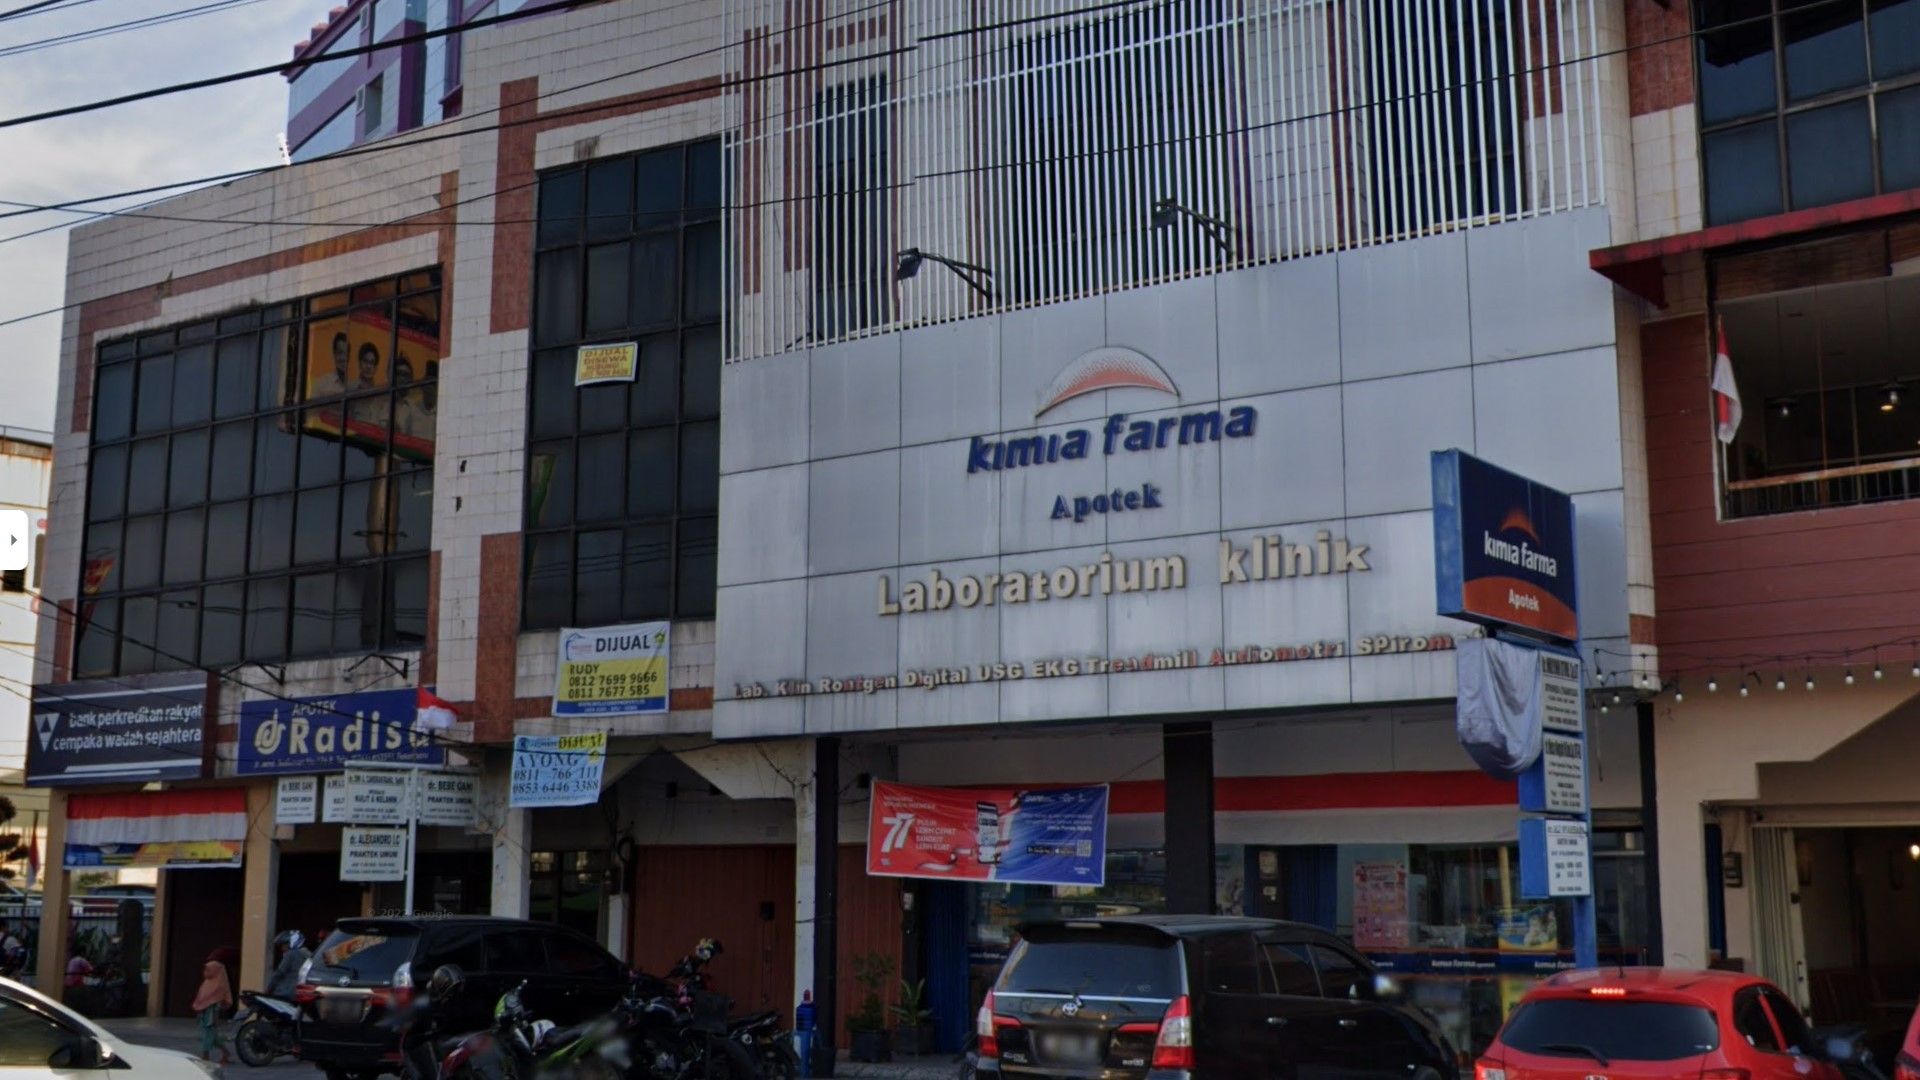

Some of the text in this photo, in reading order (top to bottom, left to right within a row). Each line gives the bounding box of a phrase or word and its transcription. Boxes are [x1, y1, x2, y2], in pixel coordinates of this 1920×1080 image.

[966, 404, 1259, 475] kimia farma
[1050, 483, 1163, 523] Apotek
[1484, 530, 1557, 577] kimia farma
[878, 529, 1372, 616] Laboratorium klinik
[1508, 589, 1540, 612] Apotek
[596, 635, 650, 652] DIJUAL
[569, 664, 600, 674] RUDY
[734, 682, 768, 699] Lab.
[819, 675, 898, 694] Rontgen
[905, 668, 967, 690] Digital
[978, 663, 1022, 681] USG
[1032, 659, 1079, 677] EKG
[1086, 650, 1197, 674] Treadmill
[569, 672, 658, 687] 0812 7699 9666
[568, 684, 650, 699] 0811 7677 585
[69, 704, 203, 729] bank perkreditan rakyat
[292, 700, 337, 717] APOTEK
[53, 728, 202, 753] cempaka wadah sejahtera
[518, 753, 579, 768] AYONG
[514, 769, 539, 781] 0811
[512, 782, 539, 794] 0853
